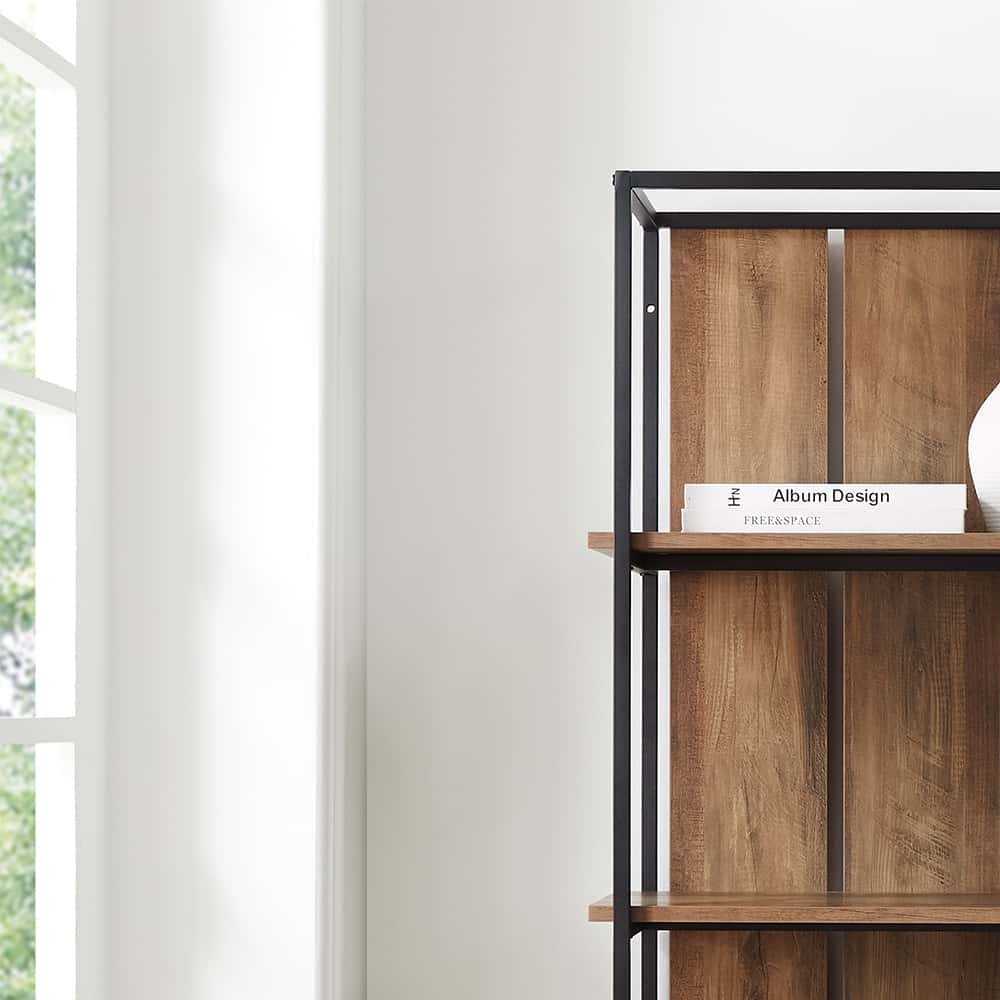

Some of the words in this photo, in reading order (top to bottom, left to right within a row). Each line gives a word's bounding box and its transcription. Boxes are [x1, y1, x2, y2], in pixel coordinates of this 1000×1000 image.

[773, 489, 828, 503] Album
[832, 489, 890, 506] Design
[744, 515, 822, 526] FREE&SPACE
